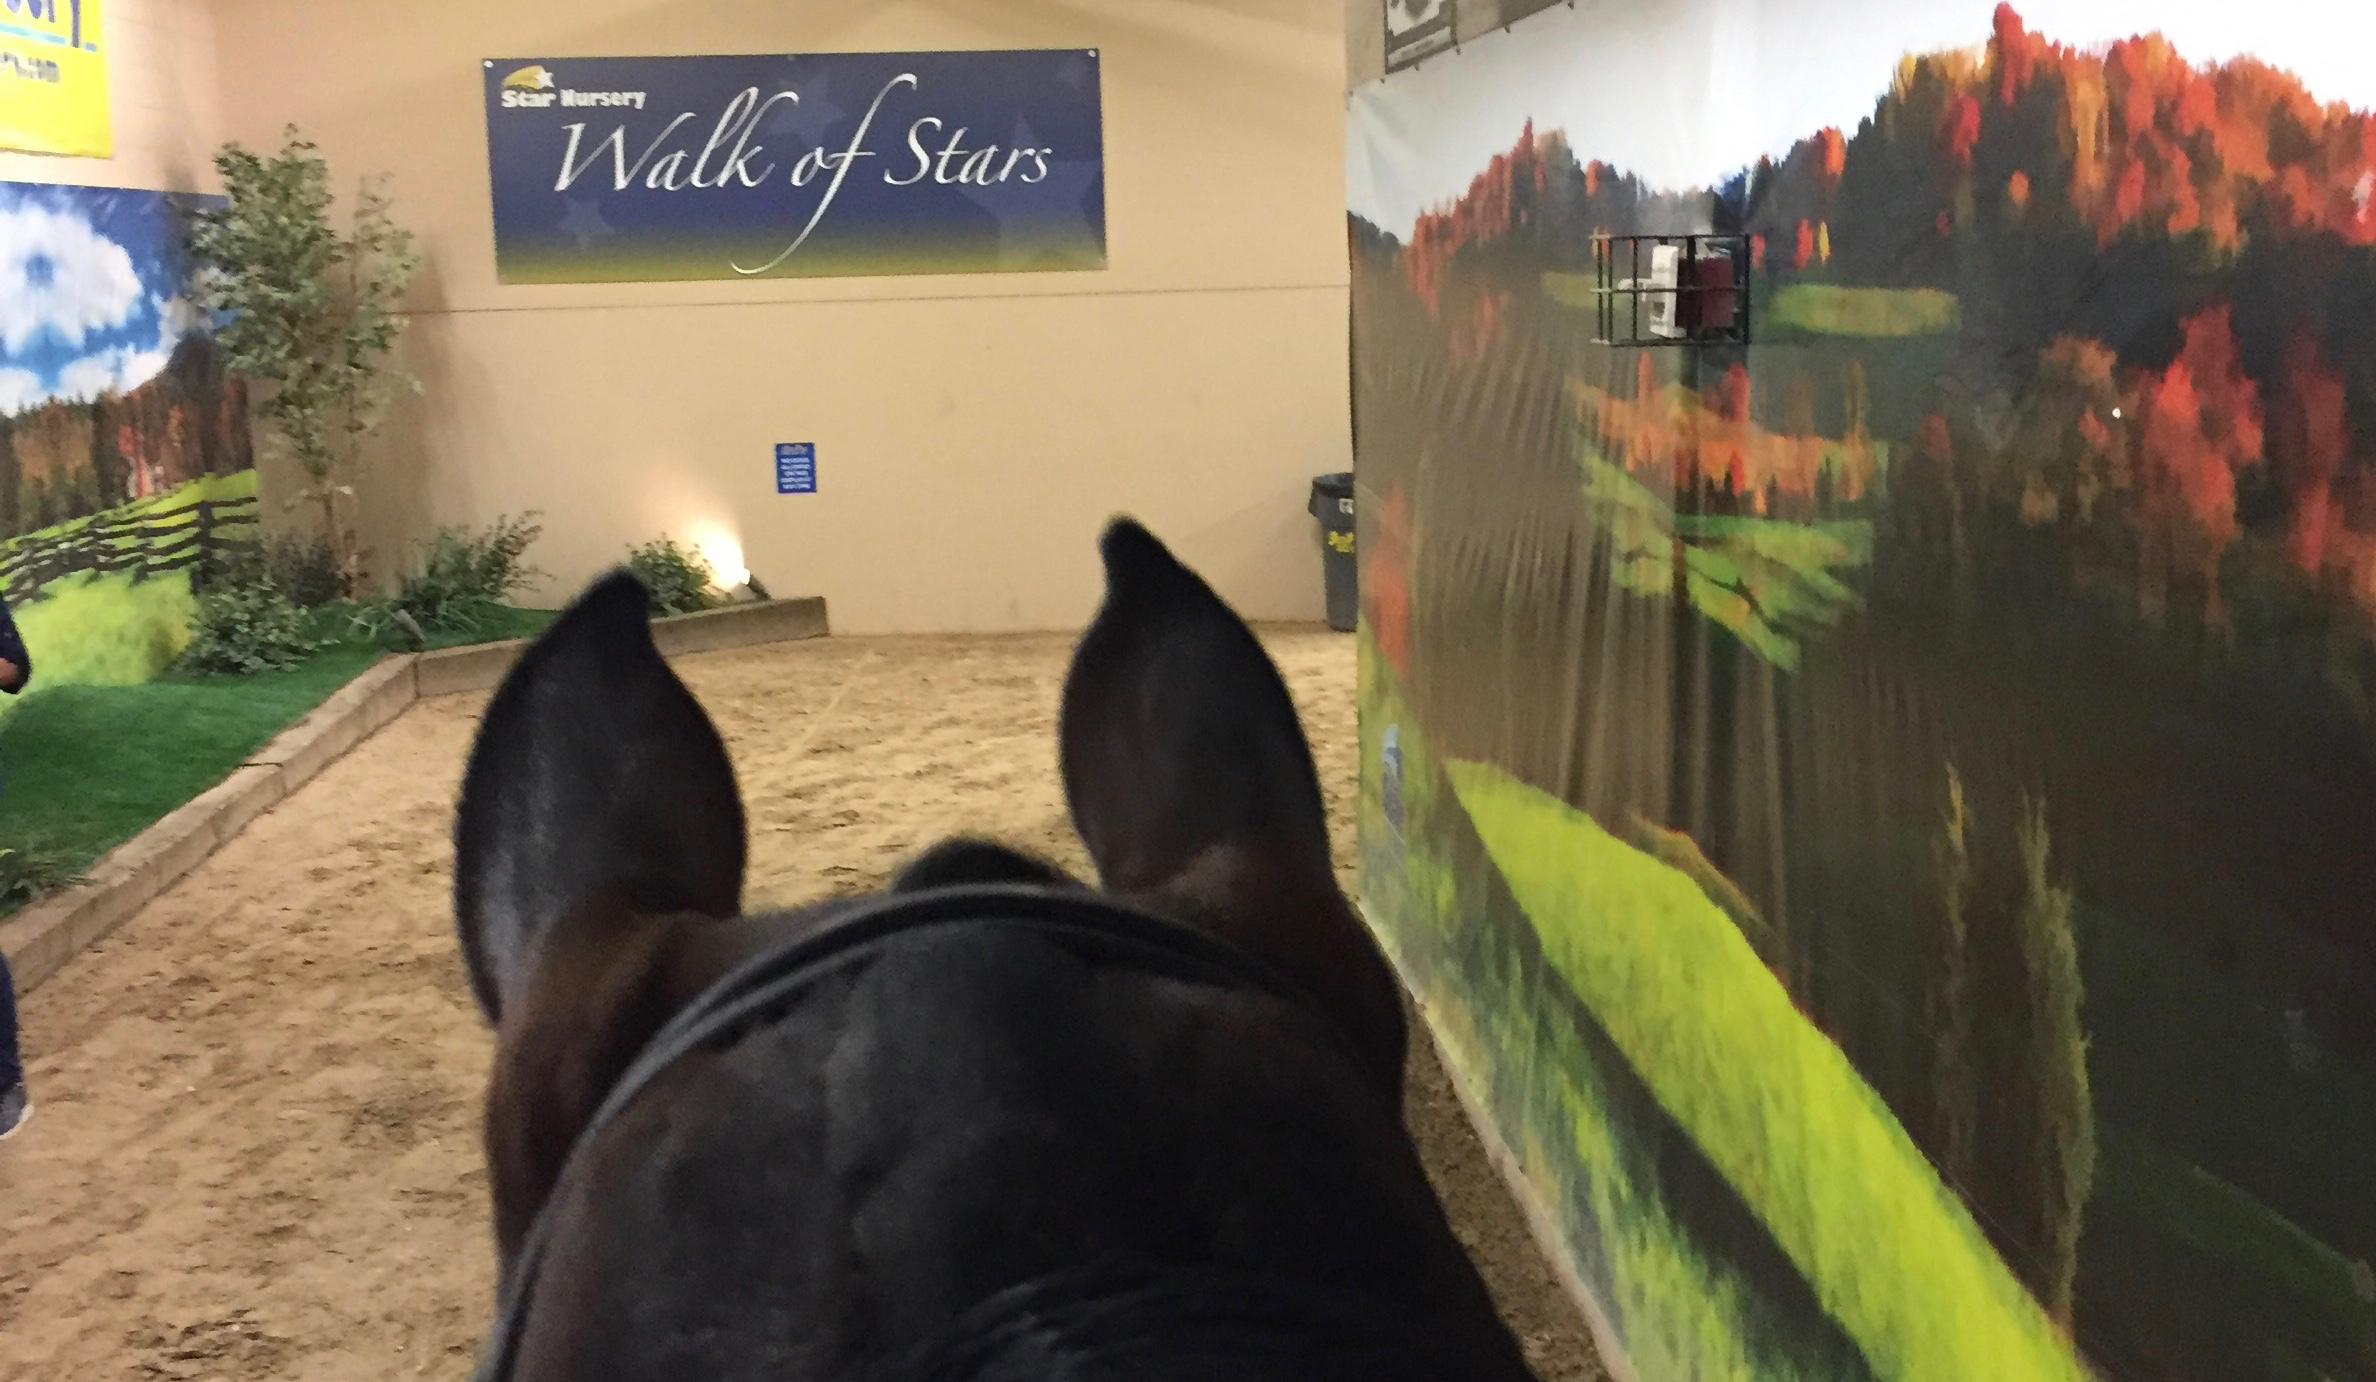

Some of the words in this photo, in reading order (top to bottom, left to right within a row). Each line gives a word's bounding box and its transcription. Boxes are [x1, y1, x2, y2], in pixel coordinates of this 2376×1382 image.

[501, 89, 557, 108] Star
[559, 88, 647, 110] Nursery
[553, 86, 799, 192] Walk
[729, 72, 918, 275] of
[883, 116, 1052, 186] Stars
